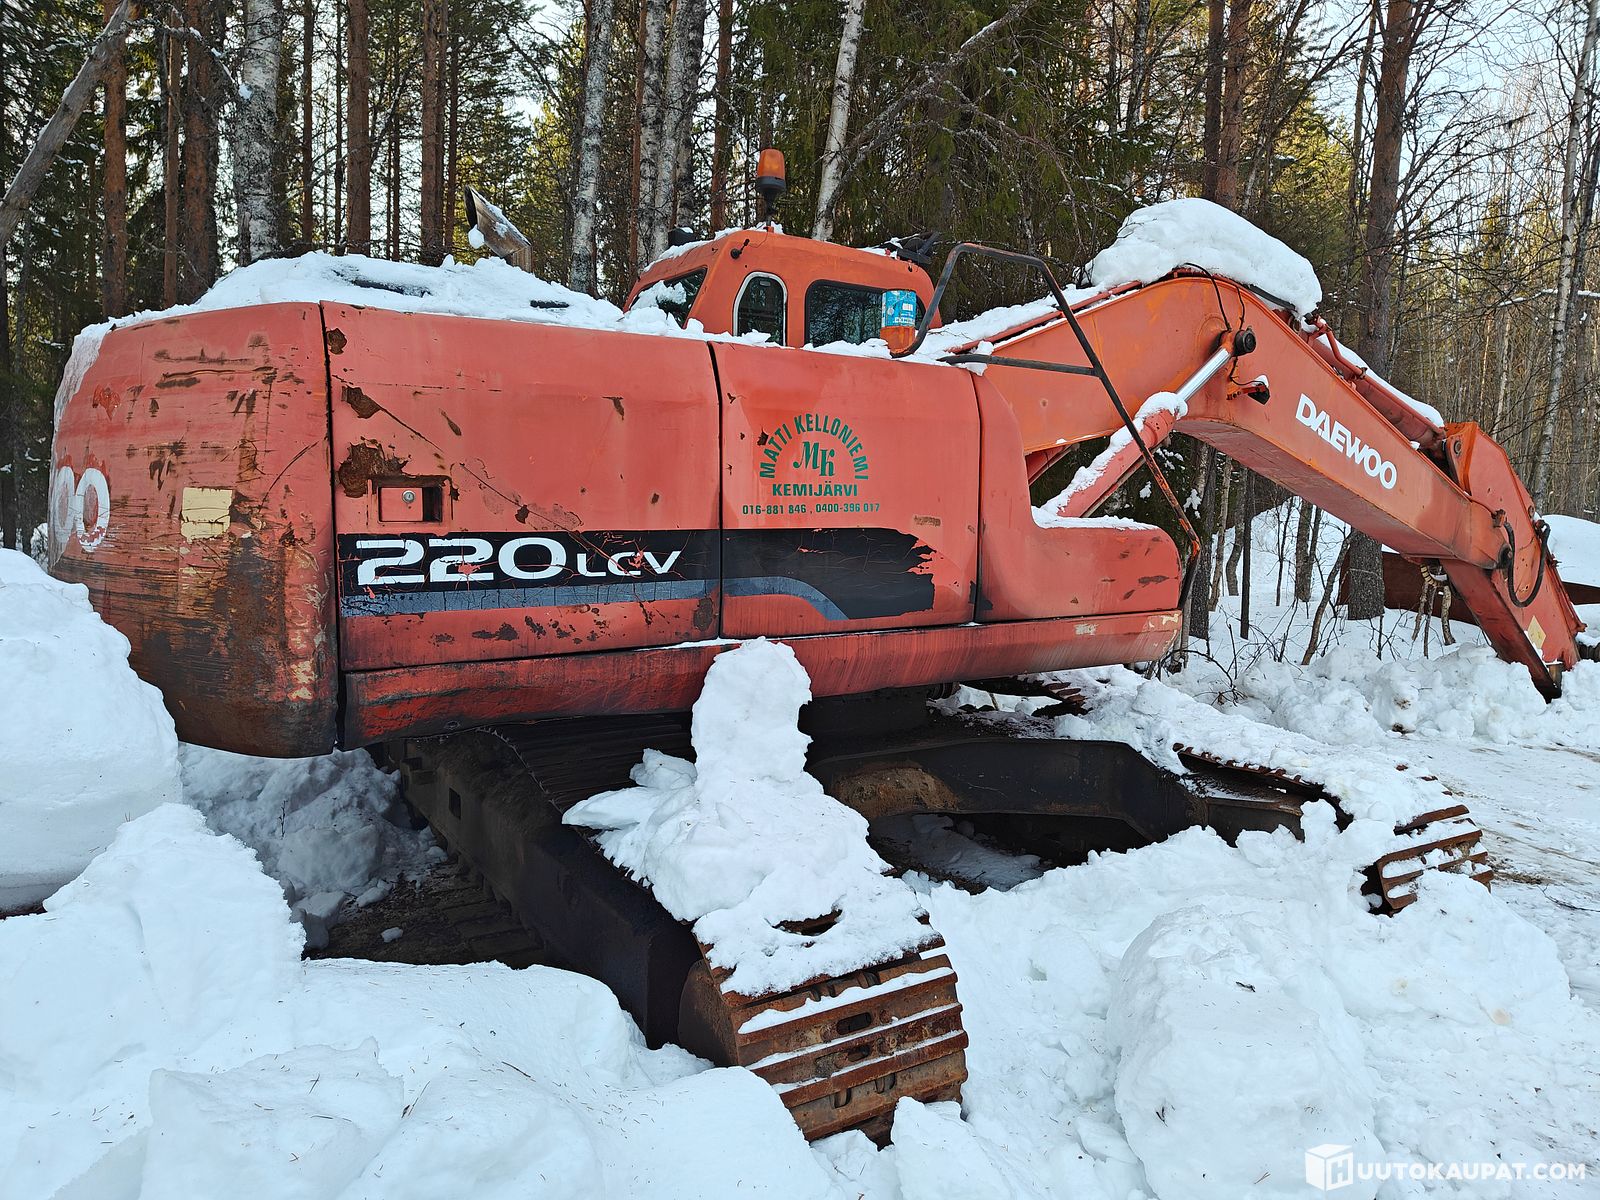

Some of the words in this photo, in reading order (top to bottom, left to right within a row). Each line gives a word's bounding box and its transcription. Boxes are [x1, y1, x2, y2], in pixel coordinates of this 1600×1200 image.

[759, 423, 793, 480] MATTI
[794, 413, 869, 480] KELLONIEMI
[1295, 393, 1398, 490] DAEWOO
[742, 504, 784, 515] 016-881
[788, 504, 807, 514] 846
[863, 503, 881, 512] 017
[772, 481, 858, 497] KEMIJÄRVI
[355, 537, 567, 586] 220
[576, 550, 682, 579] LCV
